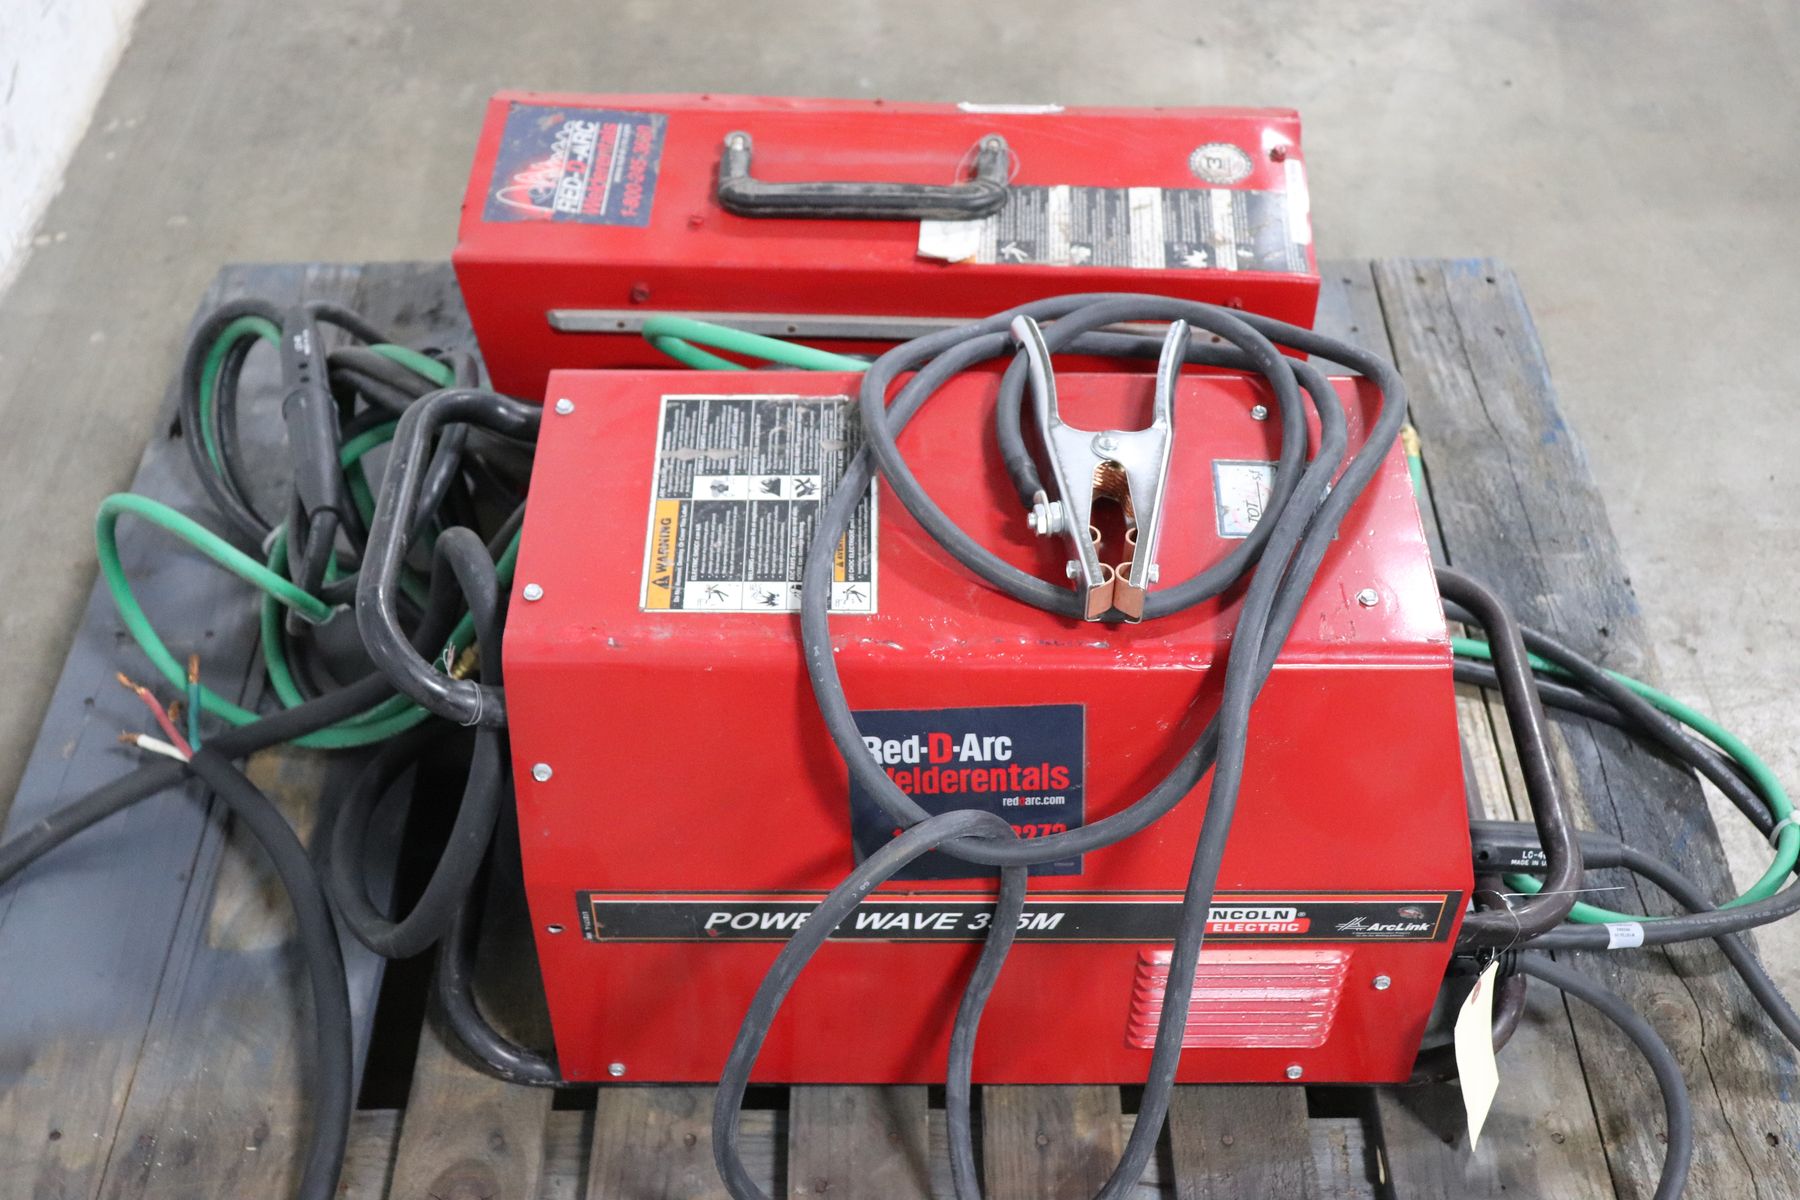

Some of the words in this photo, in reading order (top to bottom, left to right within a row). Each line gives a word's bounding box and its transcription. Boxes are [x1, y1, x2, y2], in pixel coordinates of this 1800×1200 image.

[655, 518, 671, 572] WARNING
[861, 733, 1012, 764] Red-D-Arc
[886, 763, 1070, 795] elderentals
[1522, 850, 1547, 860] LC-4
[704, 912, 840, 930] POWE
[855, 912, 963, 930] WAVE
[967, 912, 1066, 930] 35M
[1212, 910, 1290, 920] NCOLN
[1212, 923, 1300, 932] ELECTRIC
[1367, 922, 1430, 931] ArcLink
